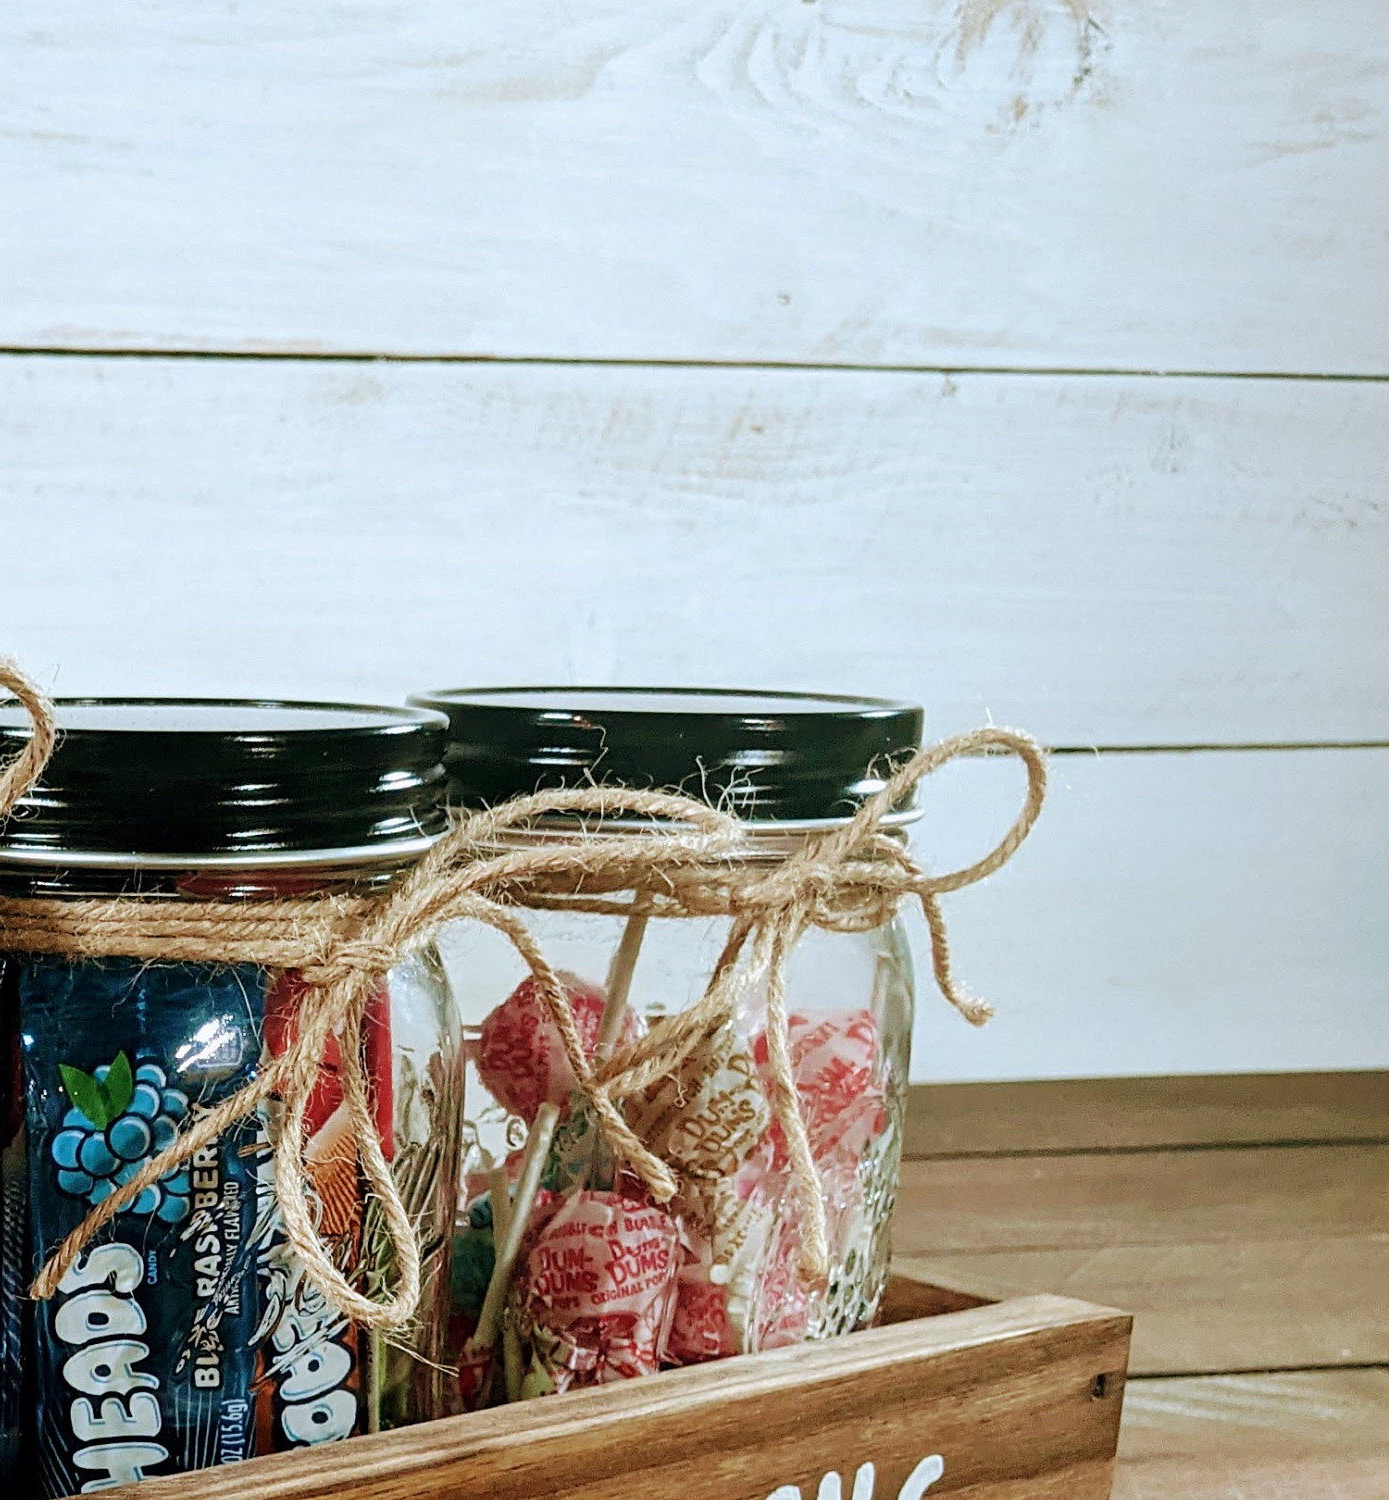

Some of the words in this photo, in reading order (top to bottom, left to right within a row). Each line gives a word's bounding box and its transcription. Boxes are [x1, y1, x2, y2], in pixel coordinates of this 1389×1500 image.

[192, 1101, 220, 1298] RASPBERY
[147, 1249, 158, 1285] CANDY
[605, 1250, 669, 1286] DUMS
